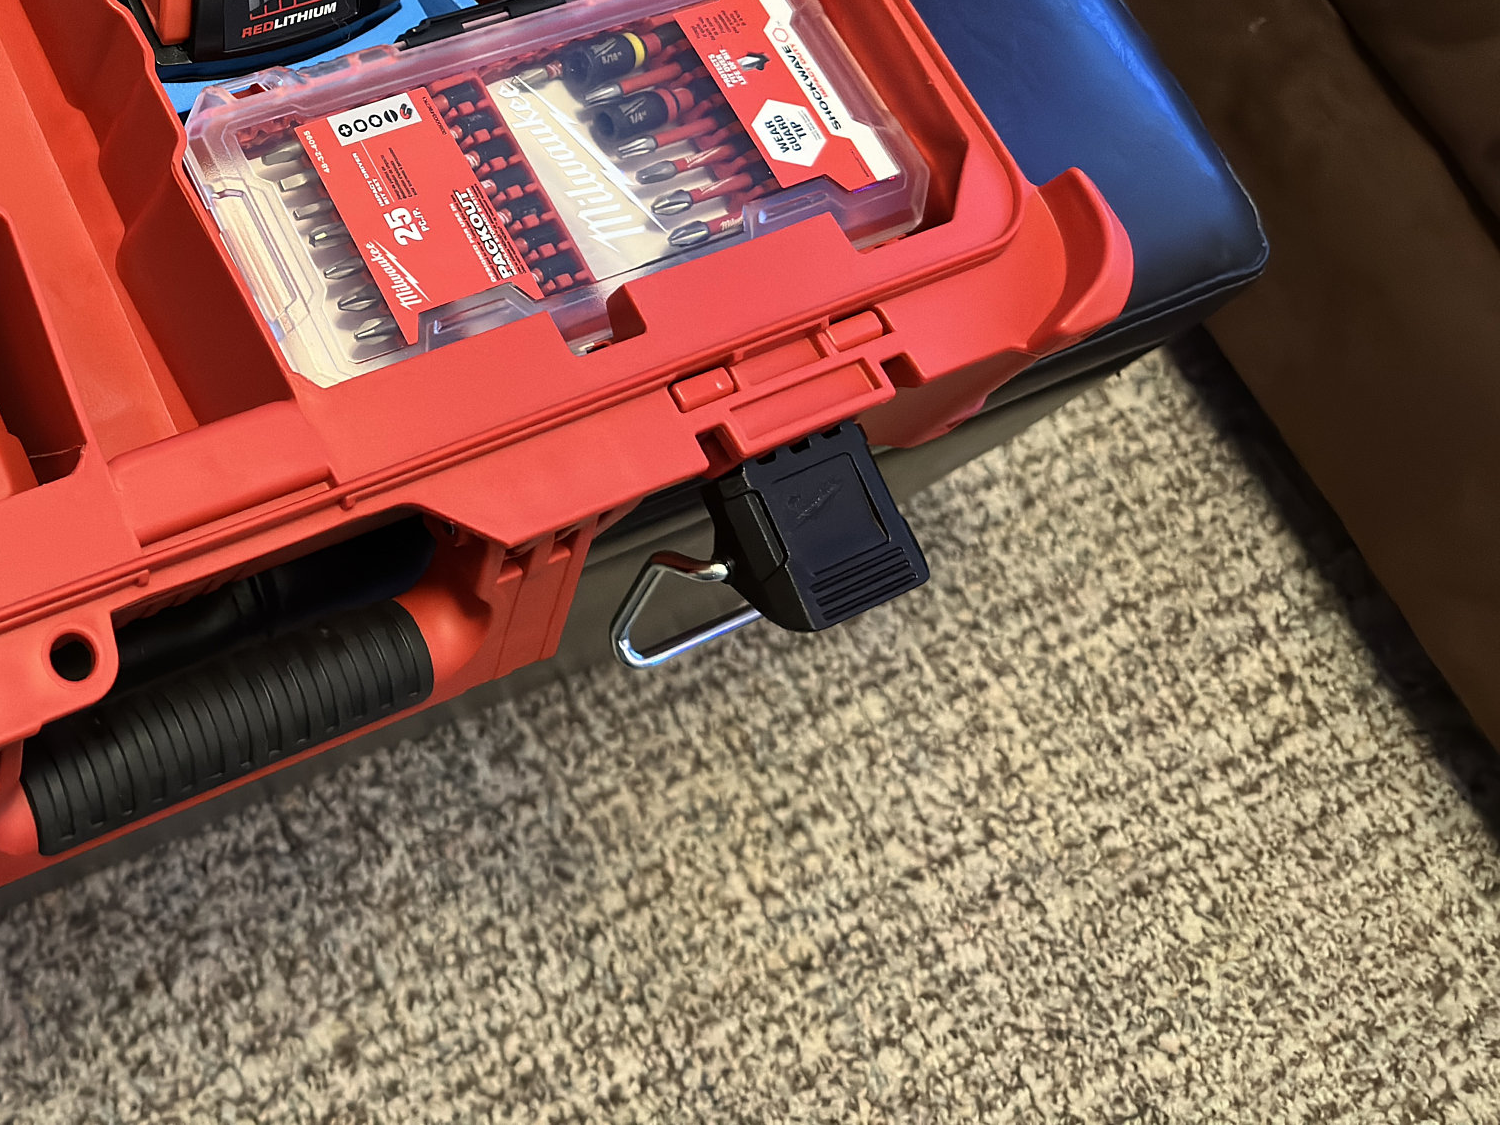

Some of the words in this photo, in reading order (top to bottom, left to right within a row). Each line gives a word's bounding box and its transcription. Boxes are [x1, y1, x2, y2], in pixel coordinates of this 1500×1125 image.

[242, 1, 337, 38] REDLITHIUM
[789, 43, 807, 64] DUTY
[708, 54, 734, 88] PROTECTS
[782, 45, 842, 130] SHOCKWAVE
[805, 67, 829, 98] IMPACT
[764, 120, 790, 153] WEAR
[773, 115, 802, 152] GUARD
[790, 121, 807, 140] TIP
[303, 130, 331, 173] 48-32-4095
[352, 152, 369, 179] DRIVER
[498, 81, 645, 253] Milwaukee
[367, 180, 385, 207] IMPACT
[372, 178, 383, 192] SET
[381, 192, 390, 205] BIT
[383, 207, 423, 246] 25
[454, 191, 514, 279] PACKOUT
[464, 228, 475, 244] FOR
[366, 241, 422, 311] Milwaukee
[473, 244, 497, 282] DESIGNED
